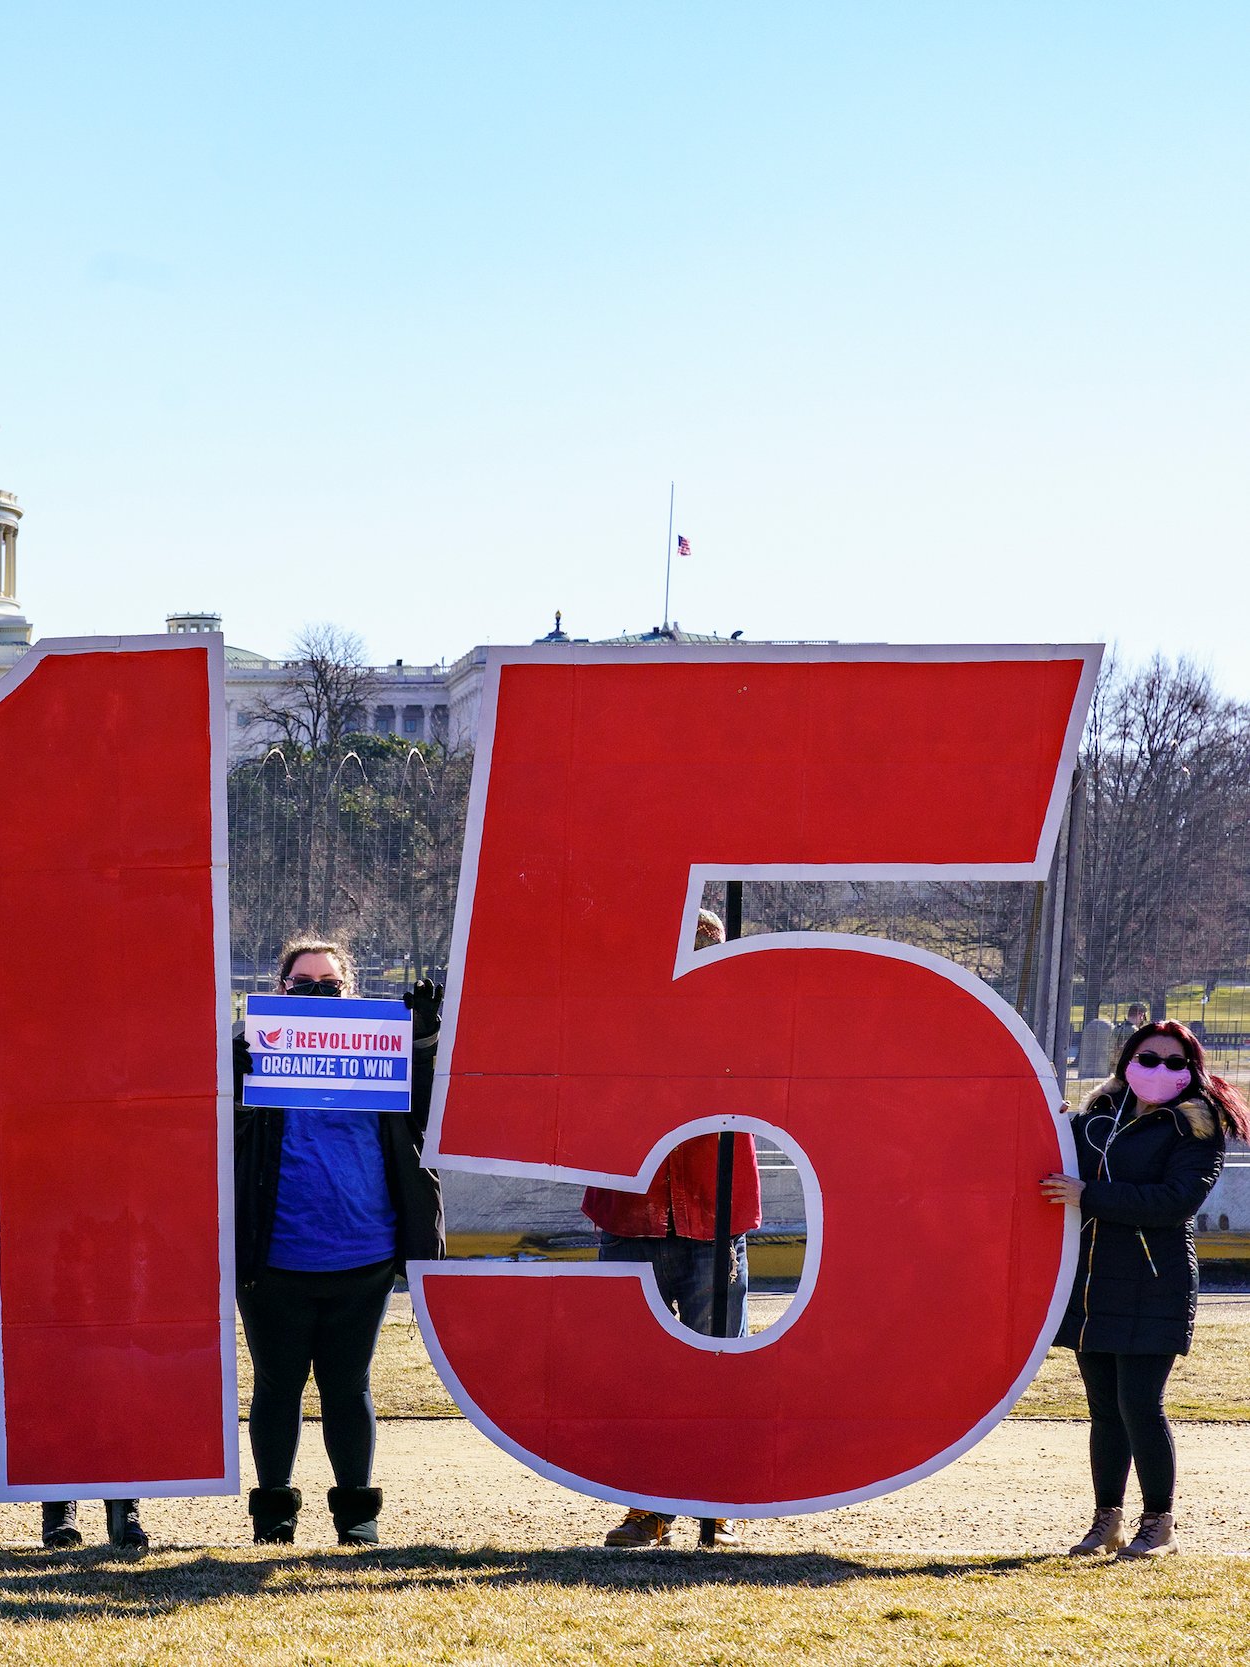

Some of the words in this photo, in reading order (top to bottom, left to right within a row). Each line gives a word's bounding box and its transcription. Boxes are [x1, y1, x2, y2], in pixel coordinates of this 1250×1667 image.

[286, 1028, 294, 1049] OUR
[296, 1031, 402, 1051] REVOLUTION
[261, 1056, 336, 1076] ORGANIZE
[340, 1058, 359, 1076] TO
[363, 1060, 393, 1077] WIN
